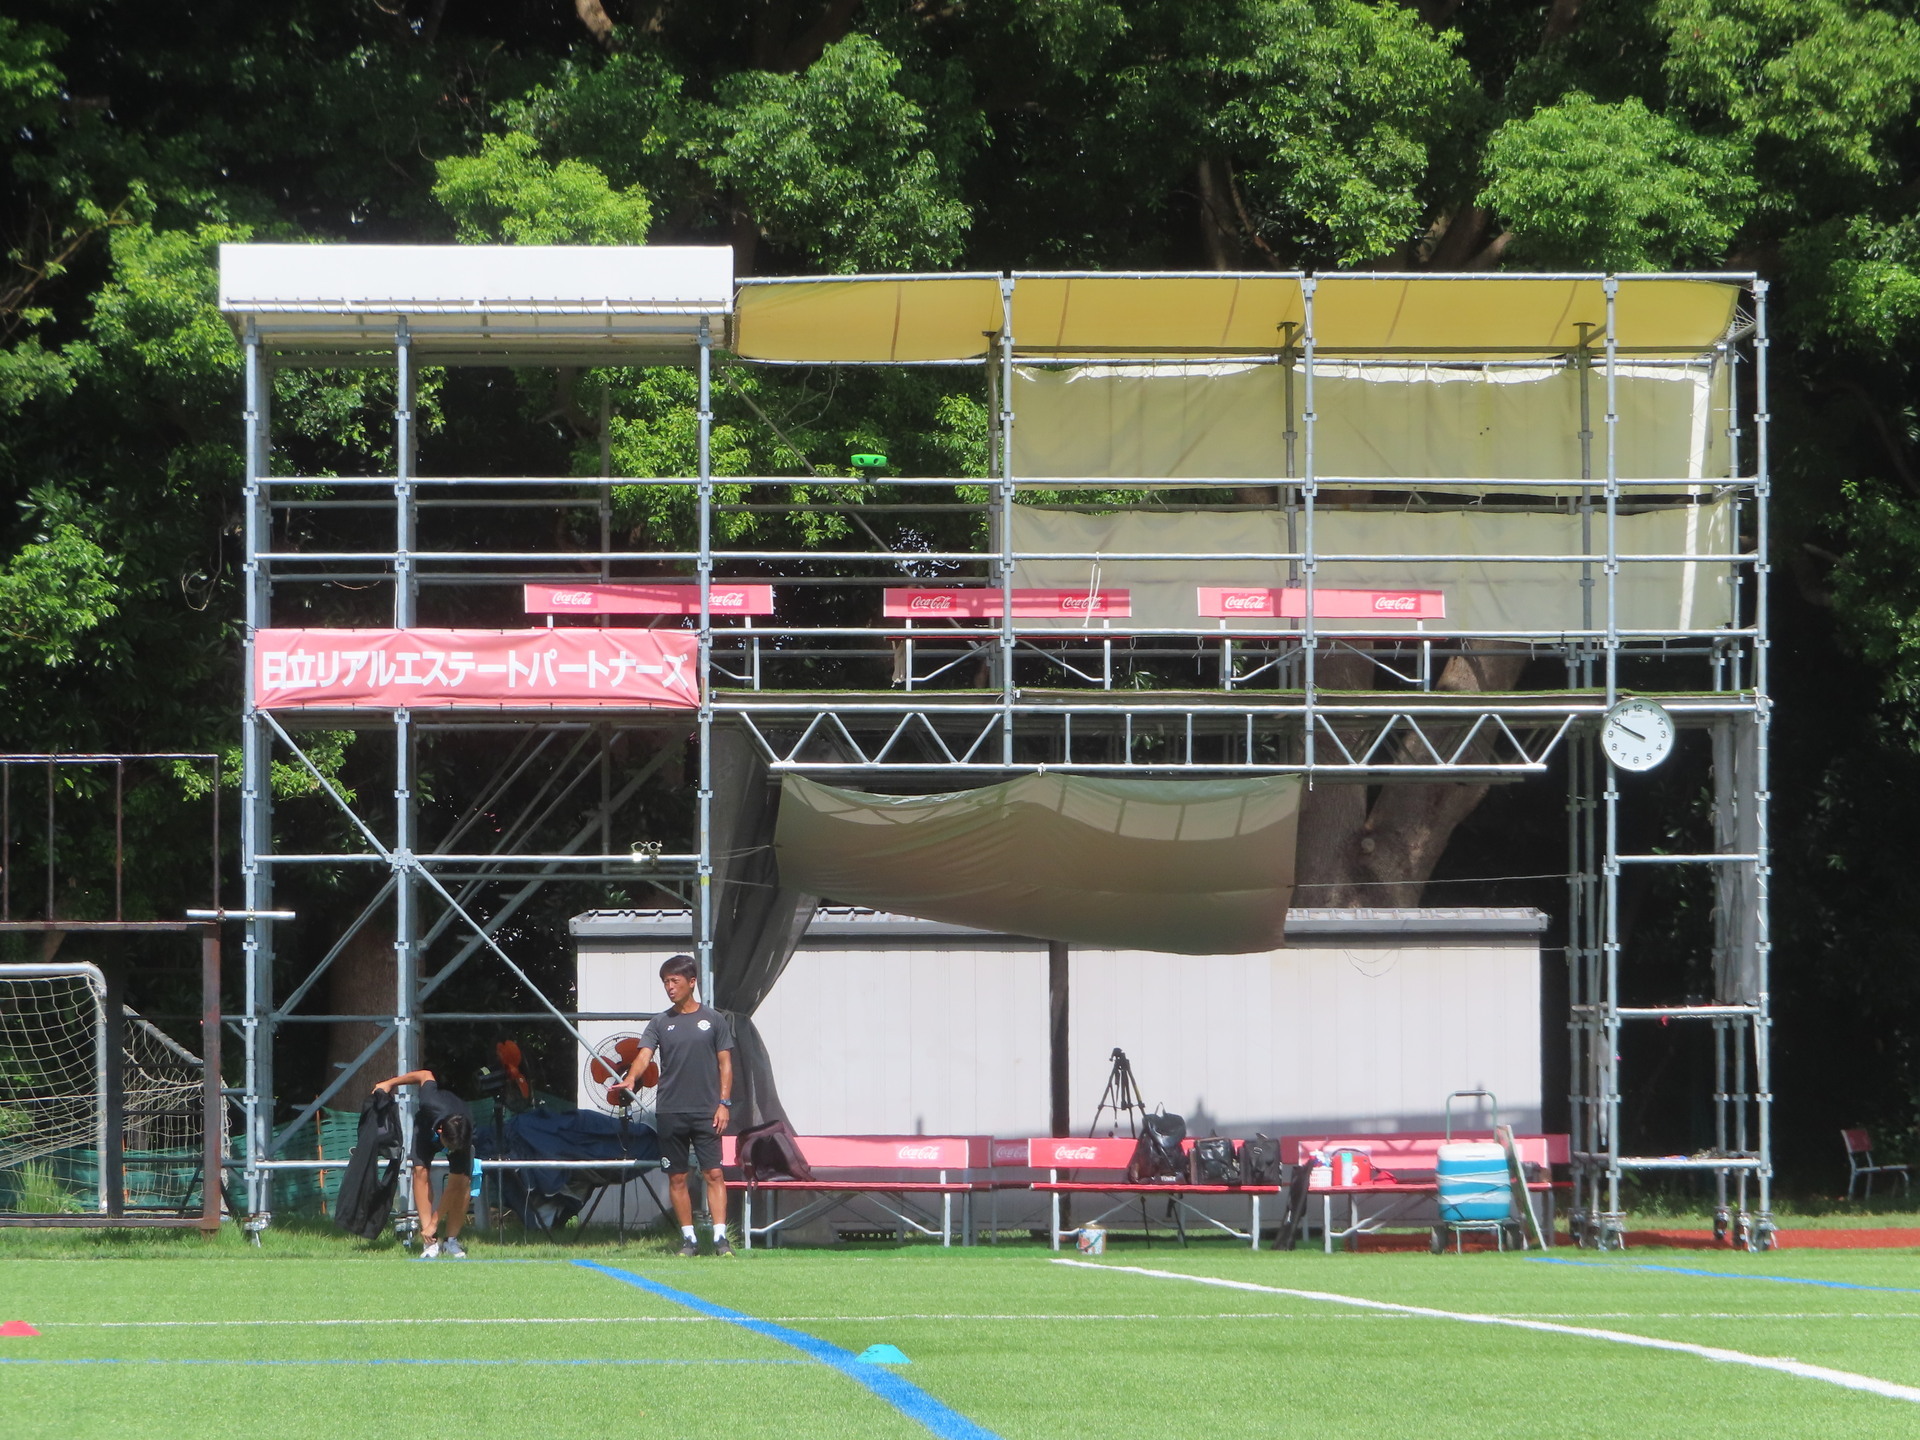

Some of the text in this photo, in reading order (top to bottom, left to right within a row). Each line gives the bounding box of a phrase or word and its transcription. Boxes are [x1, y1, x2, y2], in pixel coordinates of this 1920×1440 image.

[552, 591, 593, 606] Coca-Cola
[707, 592, 745, 606] oca-Cola
[910, 595, 952, 610] Coca-Cola
[1224, 595, 1267, 610] Coca-Cola
[1374, 596, 1417, 610] Coca-Cola
[262, 648, 689, 691] 日立リアルエステートパートナーズ
[1620, 708, 1629, 716] 11
[1633, 704, 1643, 712] 12
[1649, 708, 1653, 716] 1
[1657, 717, 1664, 725] 2
[1608, 730, 1614, 738] 9
[1660, 730, 1666, 738] 3
[1611, 743, 1618, 751] 8
[1656, 743, 1662, 751] 4
[1633, 756, 1639, 764] 6
[898, 1145, 941, 1160] Coca-Cola
[1055, 1145, 1098, 1160] Coca-Cola
